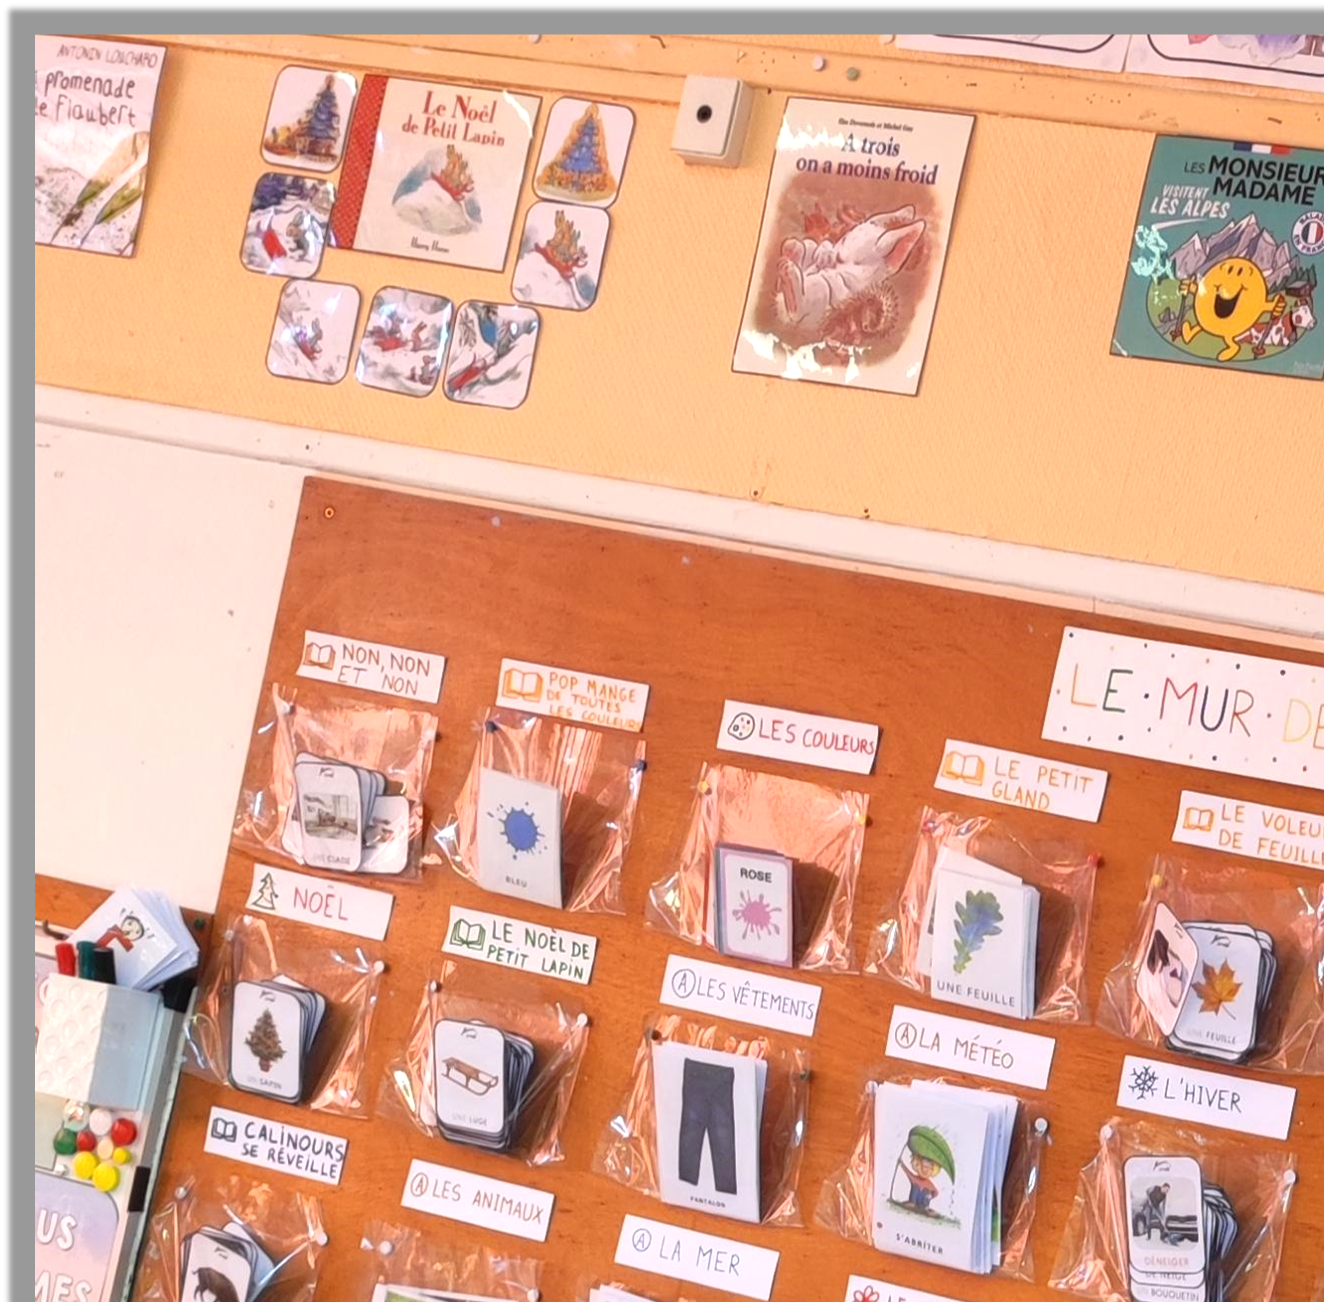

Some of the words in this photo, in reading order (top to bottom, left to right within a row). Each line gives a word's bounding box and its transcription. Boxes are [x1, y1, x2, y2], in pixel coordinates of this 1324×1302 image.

[44, 71, 135, 99] promenade
[56, 94, 136, 128] Flaubert
[422, 90, 446, 117] Le
[452, 95, 497, 123] Noël
[402, 114, 418, 133] de
[424, 117, 457, 140] Petit
[462, 123, 505, 147] Lapin
[861, 137, 900, 157] trois
[796, 157, 818, 172] on
[822, 161, 832, 174] a
[837, 159, 890, 179] moins
[894, 161, 938, 185] froid
[1184, 162, 1205, 174] LES
[1162, 184, 1210, 199] VISITENT
[1213, 177, 1316, 206] MADAME
[1150, 197, 1179, 214] LES
[1182, 200, 1230, 219] ALPES
[390, 653, 430, 676] NON
[338, 665, 367, 684] ET
[382, 674, 418, 695] NON
[550, 672, 578, 690] POP
[587, 679, 636, 703] MANGE
[547, 690, 560, 701] DE
[572, 694, 621, 713] TOUTES
[550, 705, 572, 717] LES
[1070, 663, 1134, 714] LE
[1158, 676, 1255, 738] MUR
[759, 718, 796, 744] LES
[803, 729, 876, 755] COULEURS
[994, 756, 1021, 780] LE
[1037, 766, 1093, 793] PETIT
[992, 781, 1051, 811] GLAND
[1221, 803, 1246, 823] LE
[1218, 829, 1243, 849] DE
[506, 875, 528, 888] BLEU
[740, 868, 772, 883] ROSE
[492, 920, 513, 944] LE
[571, 941, 590, 960] DE
[486, 944, 529, 968] PETIT
[541, 957, 584, 980] LAPIN
[697, 976, 726, 1000] LES
[733, 980, 814, 1021] VÊTEMENTS
[937, 980, 962, 996] UNE
[967, 986, 1015, 1007] FEUILLE
[919, 1027, 941, 1052] LA
[954, 1034, 1014, 1069] MÉTÉO
[1205, 1031, 1237, 1046] FEUILLE
[1164, 1077, 1242, 1114] L'HIVER
[244, 1122, 344, 1162] CALINOURS
[241, 1143, 258, 1157] SE
[267, 1148, 338, 1179] RÉVEILLE
[432, 1179, 461, 1201] LES
[472, 1190, 544, 1224] ANIMAUX
[690, 1196, 726, 1208] PANTALON
[659, 1236, 681, 1262] LA
[696, 1245, 740, 1276] MER
[896, 1233, 944, 1254] S'ABRITER
[1151, 1288, 1199, 1301] BOUQUETIN
